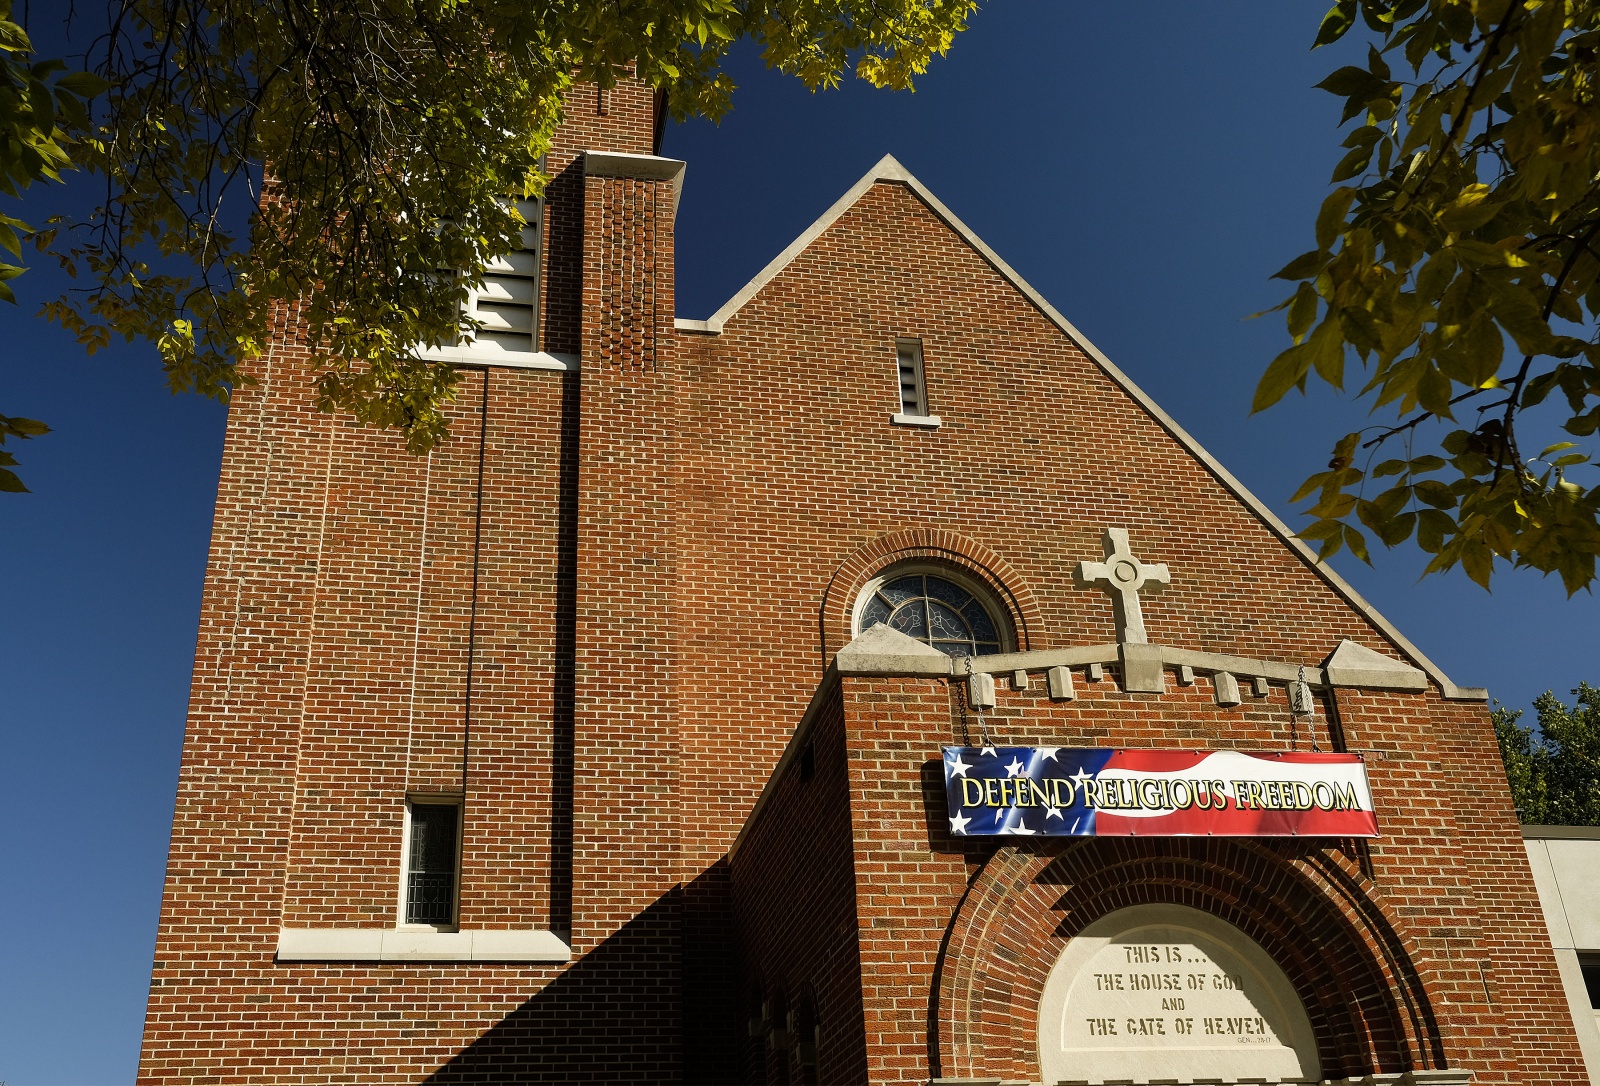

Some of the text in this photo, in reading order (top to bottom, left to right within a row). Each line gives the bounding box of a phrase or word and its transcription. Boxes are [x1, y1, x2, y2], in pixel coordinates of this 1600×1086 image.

[961, 777, 1362, 811] DEFEND RELIGIOUS FREEDOM
[1123, 946, 1160, 963] THIS
[1166, 946, 1182, 963] IS
[1094, 974, 1243, 991] THE HOUSE OF GOD
[1161, 998, 1185, 1011] AND
[1086, 1018, 1266, 1036] THE GATE OF HEAVEN
